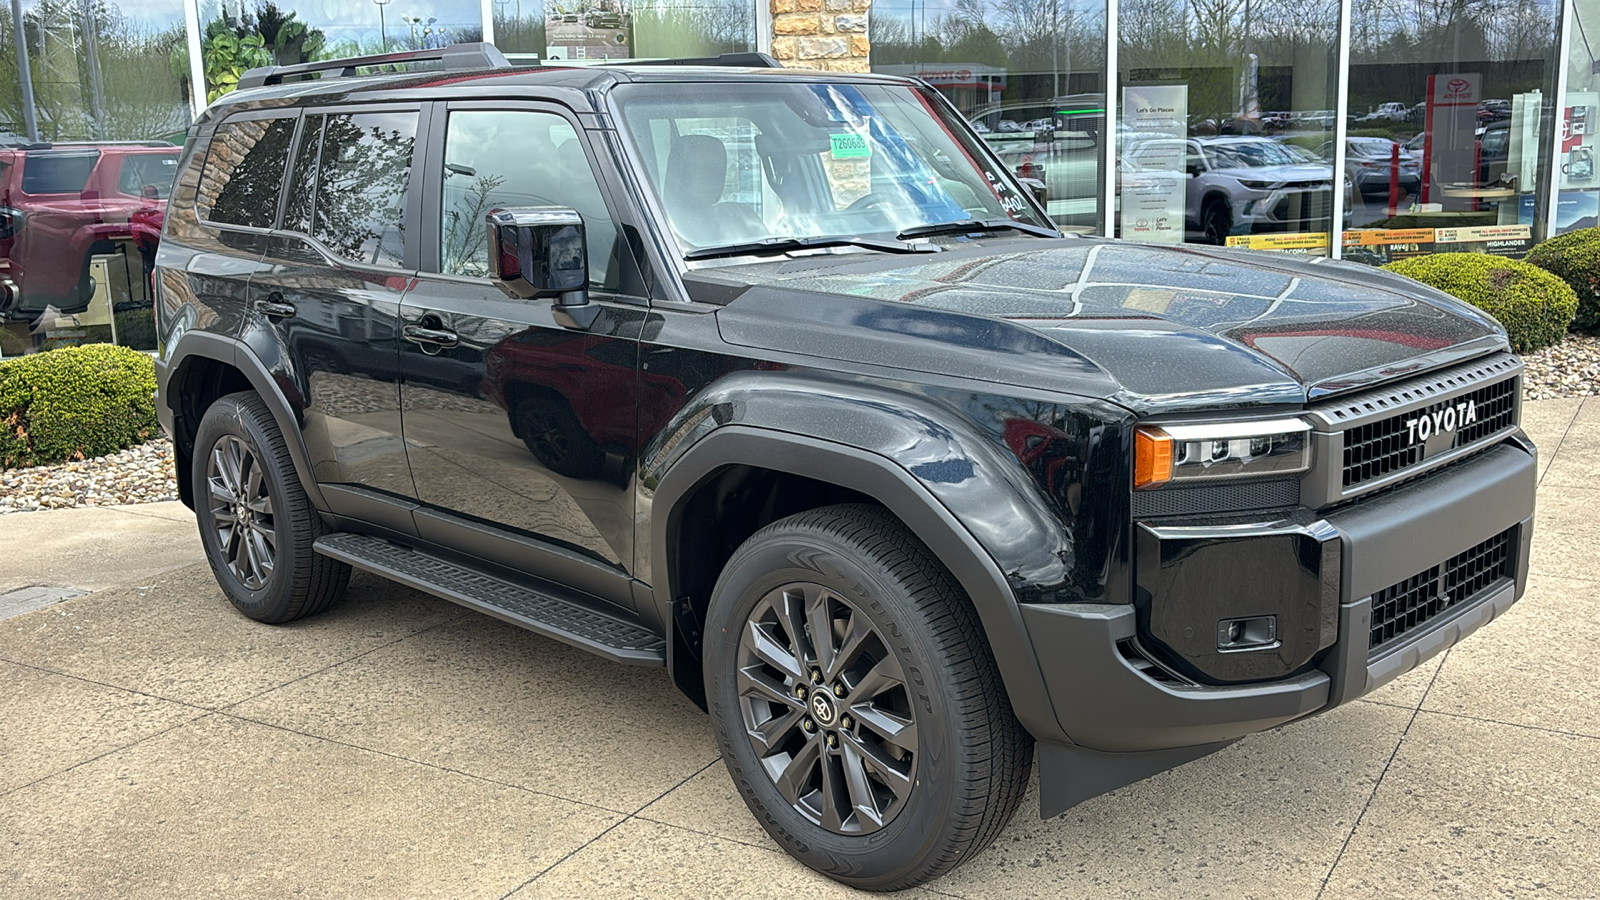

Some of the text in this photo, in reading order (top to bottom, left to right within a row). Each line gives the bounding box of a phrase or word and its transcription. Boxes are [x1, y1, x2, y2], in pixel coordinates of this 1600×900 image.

[832, 138, 866, 149] T260689
[1406, 400, 1477, 445] TOYOTA
[852, 581, 933, 715] DUNLOP
